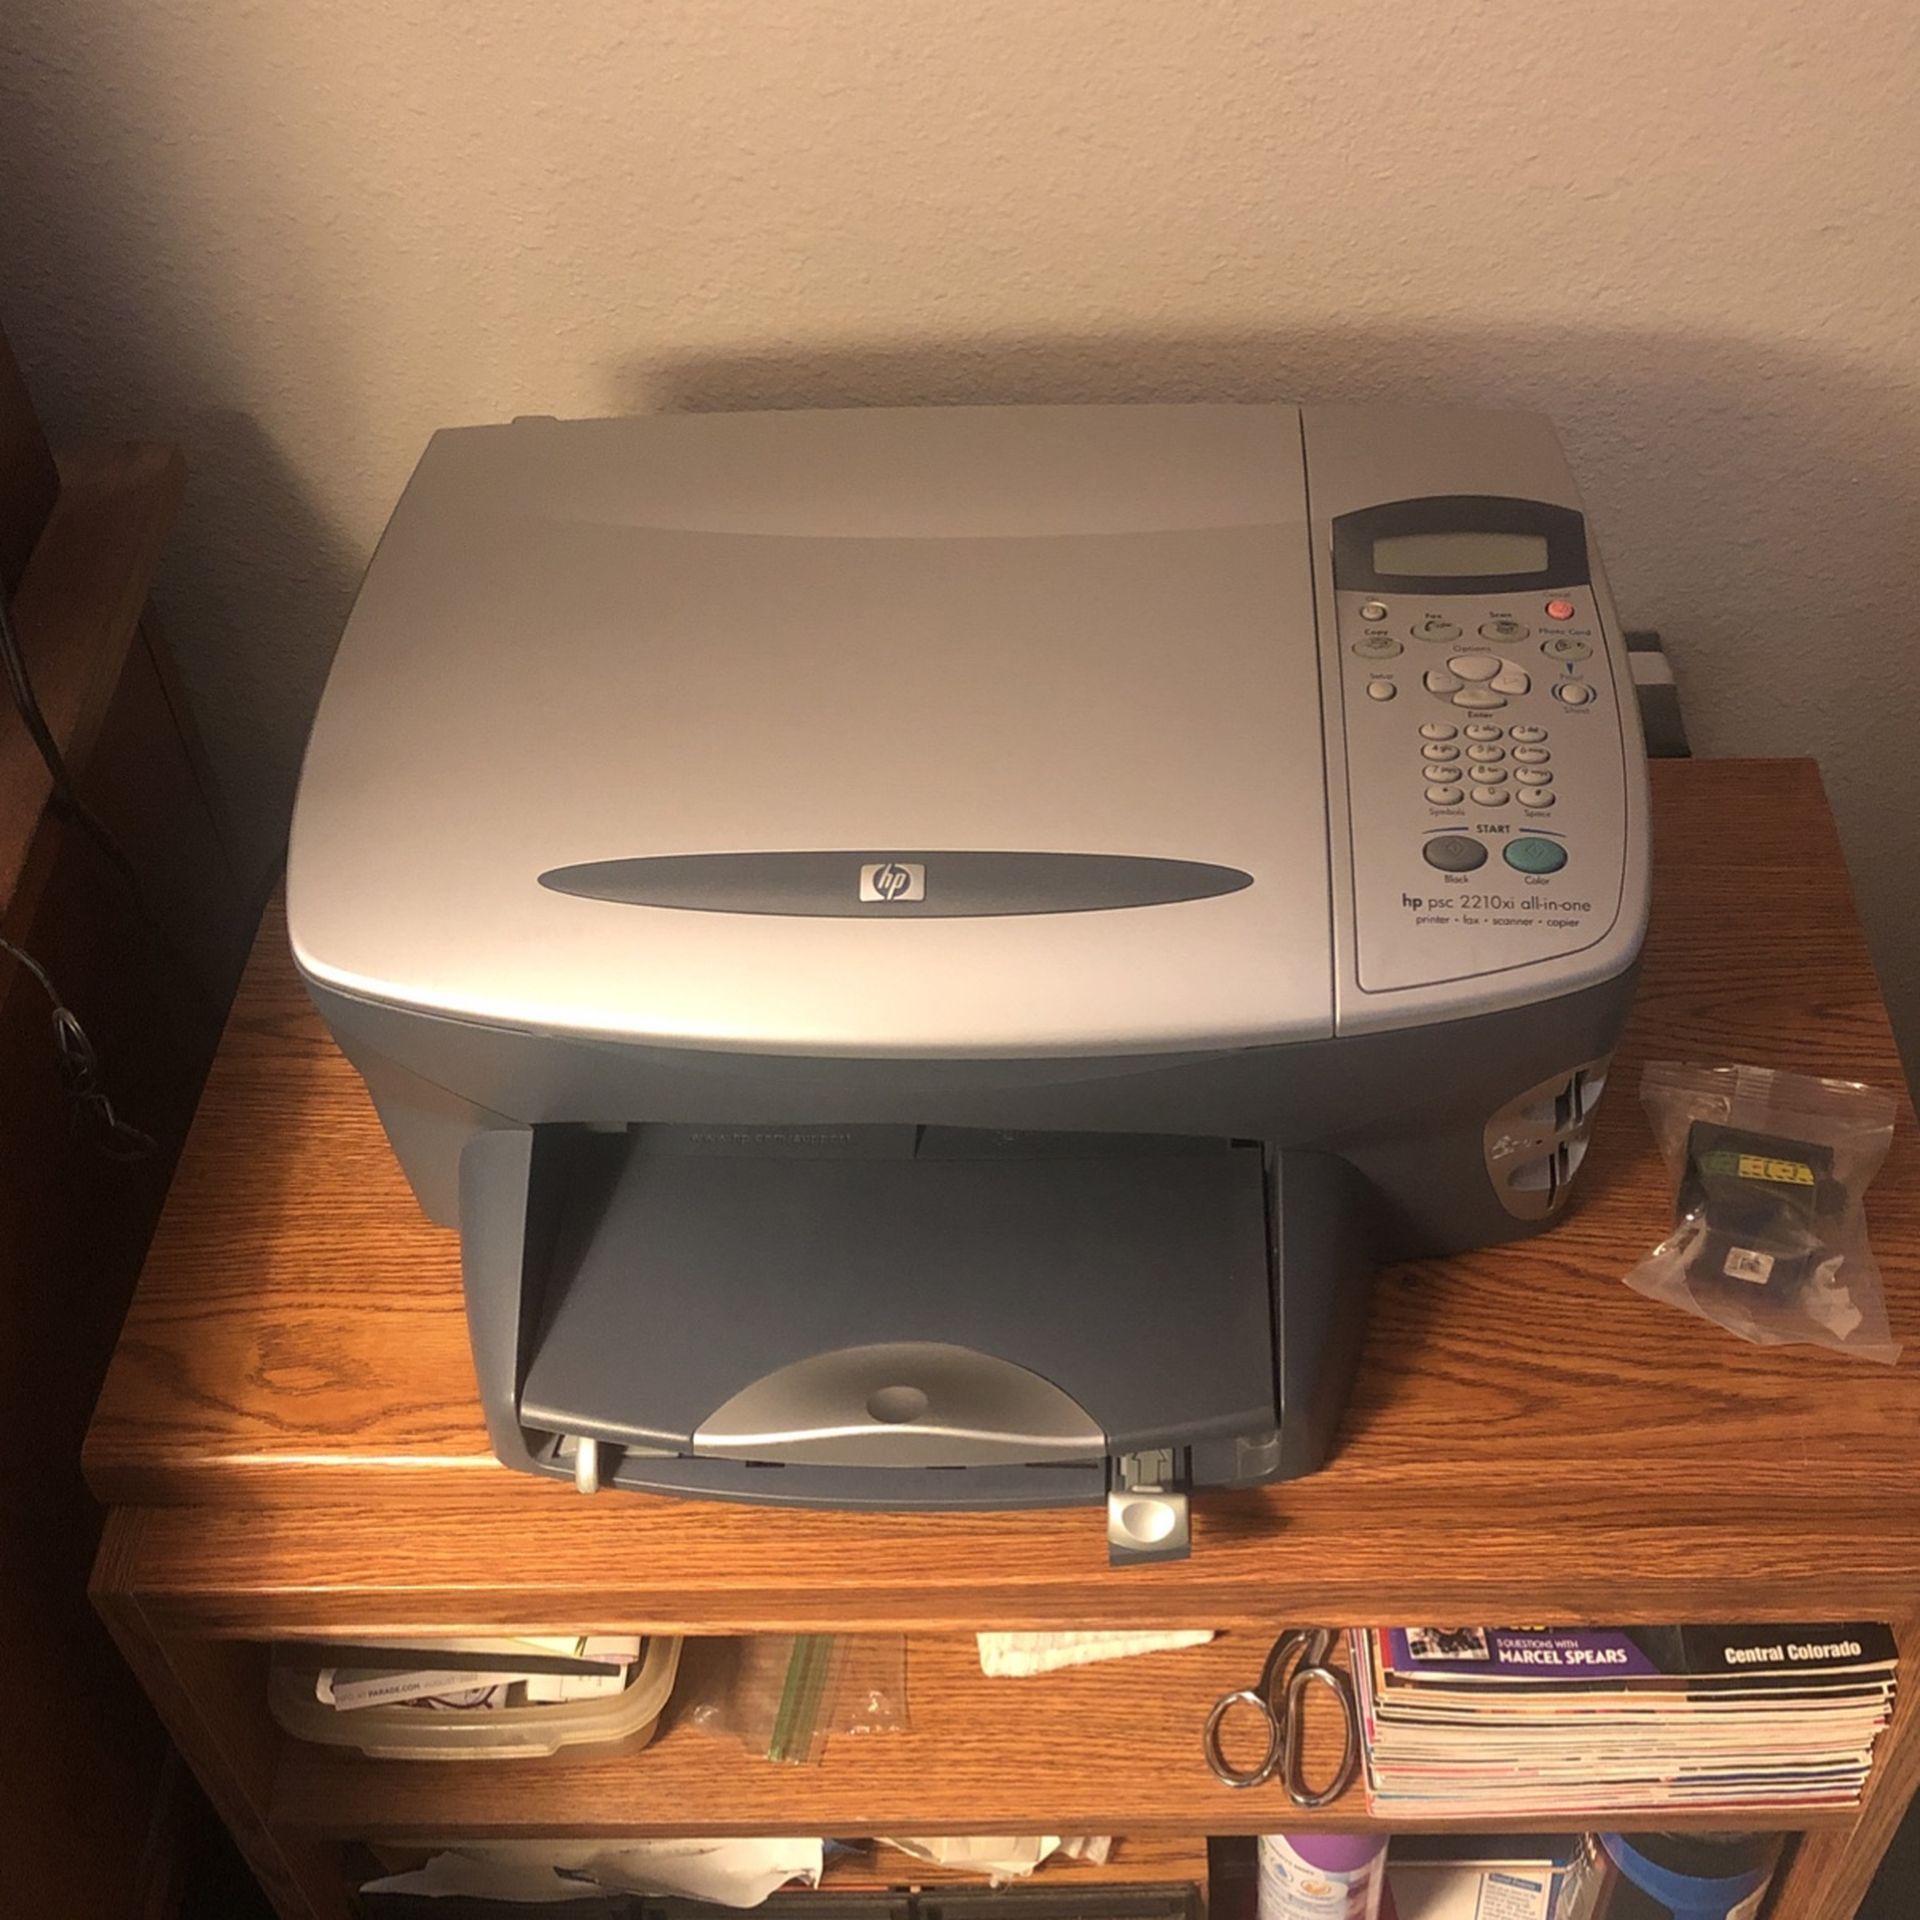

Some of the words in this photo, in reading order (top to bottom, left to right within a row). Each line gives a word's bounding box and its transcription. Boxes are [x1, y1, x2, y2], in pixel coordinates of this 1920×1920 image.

[1364, 628, 1388, 636] Copy
[1429, 808, 1466, 817] Symbols
[1476, 824, 1511, 834] START
[878, 863, 907, 901] hp
[1444, 874, 1469, 884] Black
[1524, 875, 1550, 886] Color
[1402, 893, 1422, 911] hp
[1428, 897, 1454, 911] psc
[1460, 894, 1514, 910] 2210xi
[1520, 895, 1592, 912] all-in-one
[1416, 915, 1450, 925] printer
[1463, 913, 1480, 925] fax
[1492, 915, 1533, 926] scanner
[1546, 917, 1580, 929] copier
[1503, 1639, 1553, 1649] QUESTIONS
[1554, 1639, 1578, 1649] WITH
[1499, 1649, 1562, 1665] MARCEL
[1565, 1649, 1628, 1665] SPEARS
[1724, 1645, 1785, 1665] Central
[1787, 1640, 1862, 1660] Colorado
[367, 1682, 420, 1699] PARADE.COM
